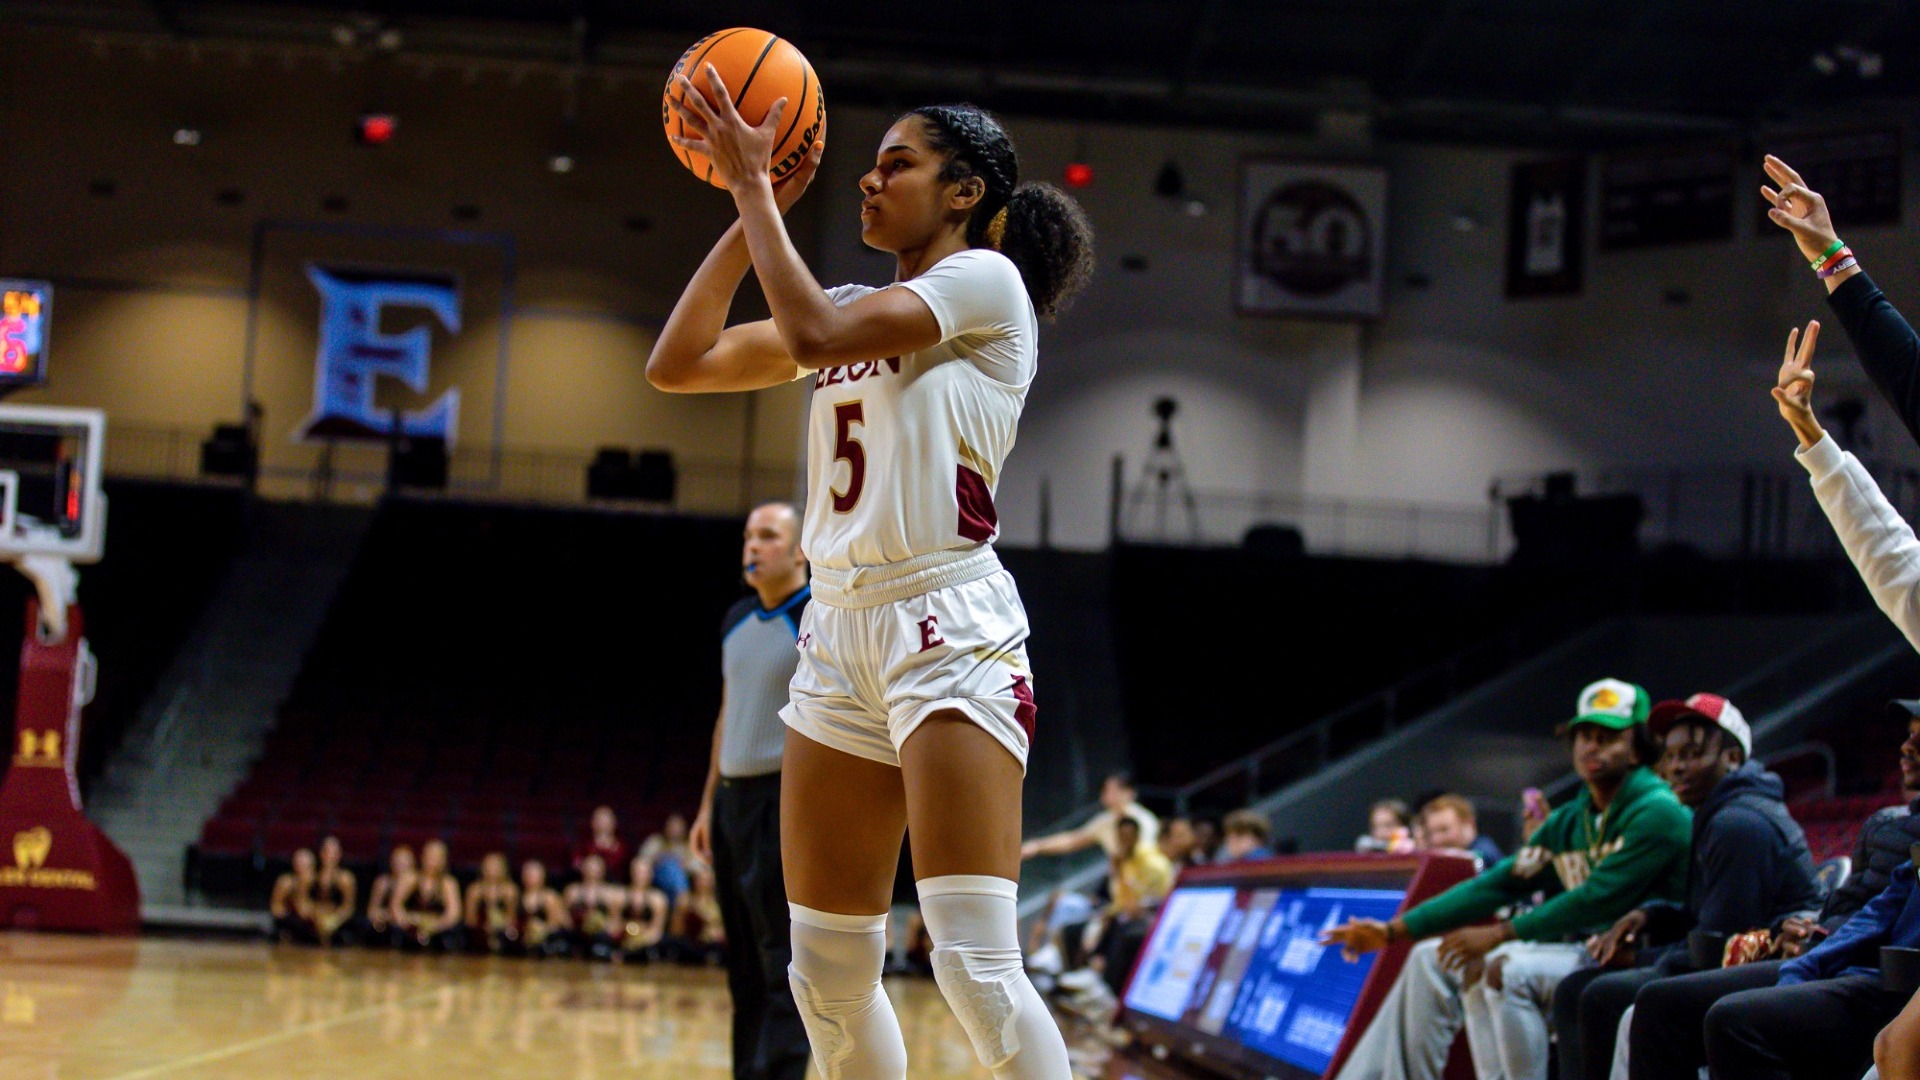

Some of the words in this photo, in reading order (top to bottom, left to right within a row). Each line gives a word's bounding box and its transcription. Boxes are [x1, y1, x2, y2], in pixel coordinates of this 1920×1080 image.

[770, 84, 823, 177] Wilson
[290, 265, 461, 452] E
[830, 400, 866, 515] 5
[917, 616, 945, 654] E
